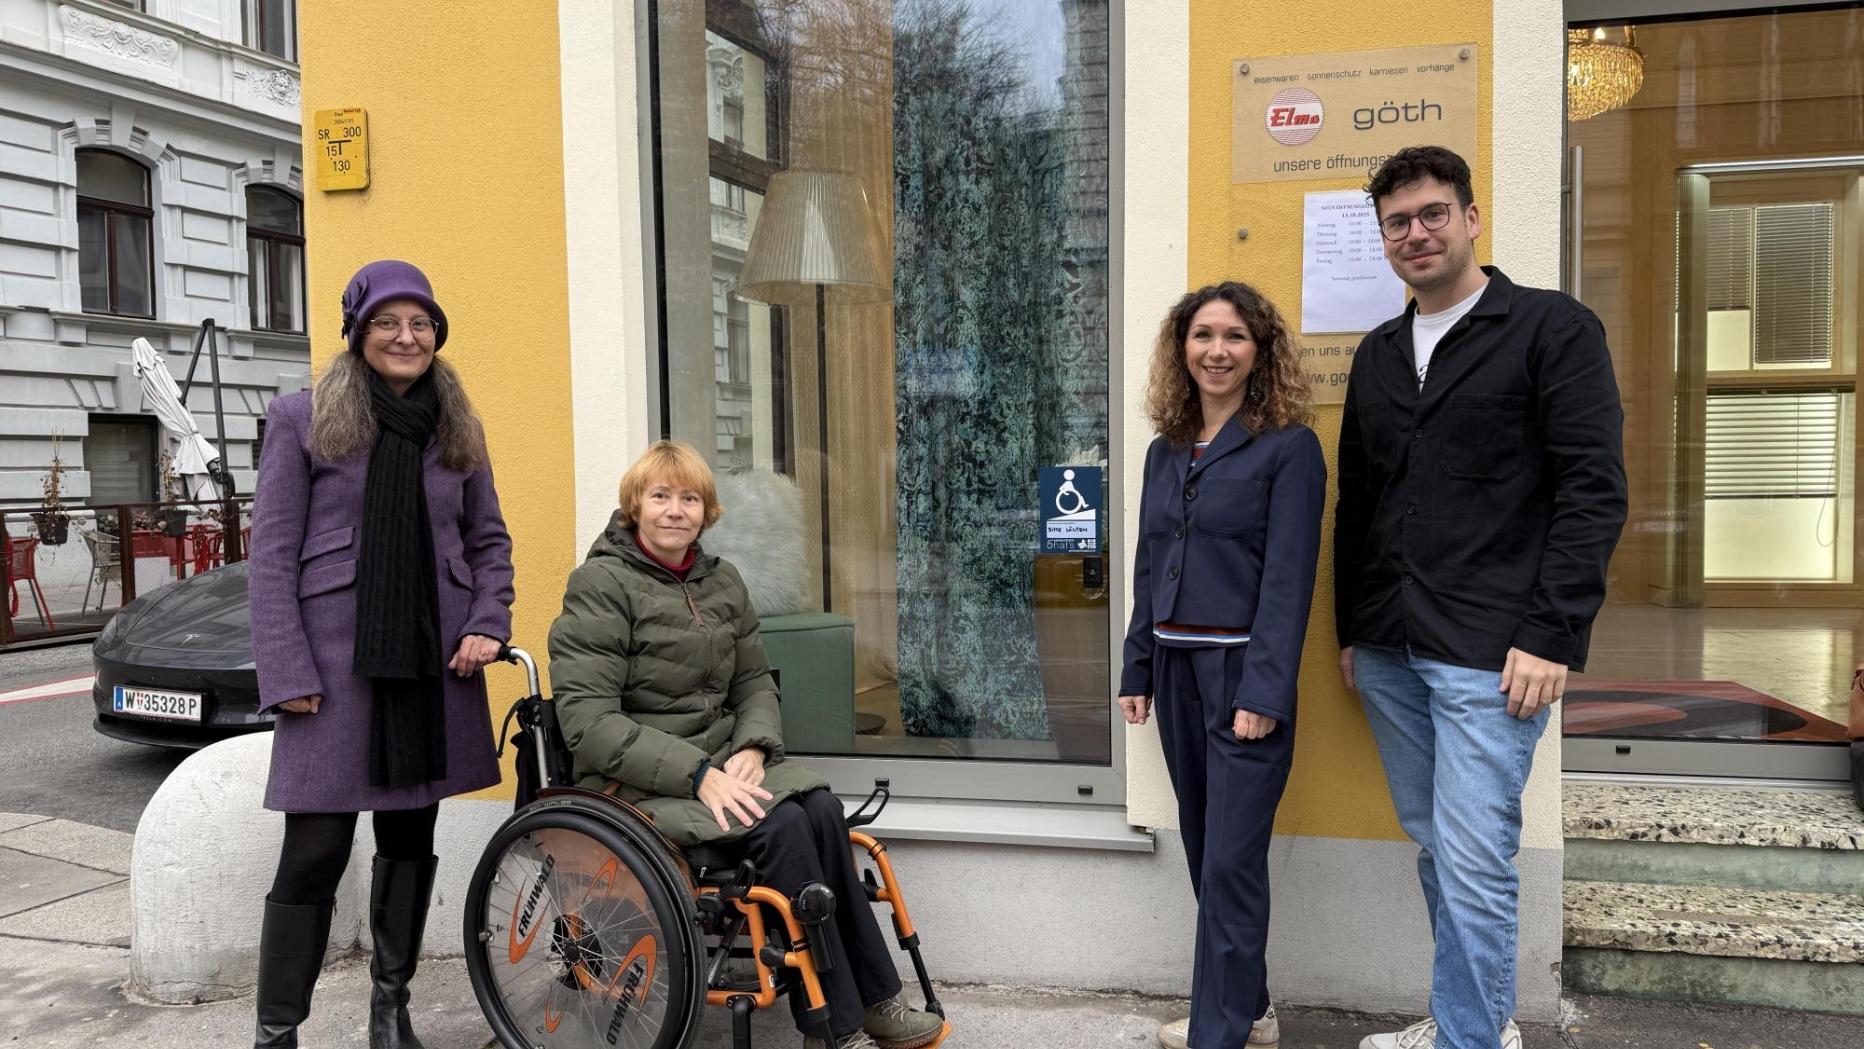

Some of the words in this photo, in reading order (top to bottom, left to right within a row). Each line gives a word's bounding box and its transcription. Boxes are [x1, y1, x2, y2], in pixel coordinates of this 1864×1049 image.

[1307, 69, 1361, 80] sonnenschutz
[1270, 107, 1320, 127] Elmo
[1354, 99, 1442, 130] göth
[318, 129, 330, 140] SR
[343, 126, 361, 138] 300
[1273, 159, 1321, 172] unsere
[1319, 346, 1341, 356] uns
[125, 691, 136, 709] W
